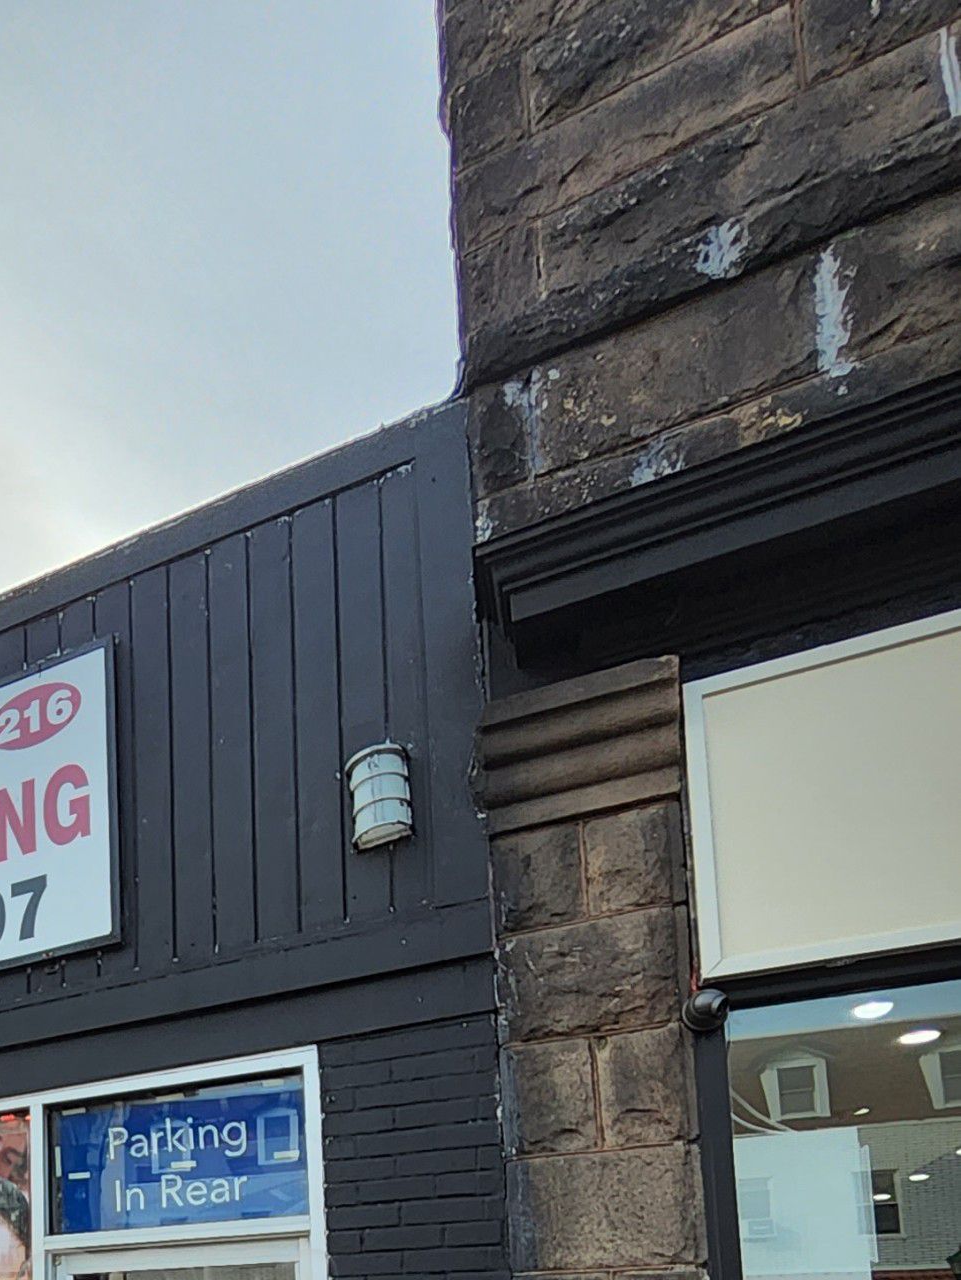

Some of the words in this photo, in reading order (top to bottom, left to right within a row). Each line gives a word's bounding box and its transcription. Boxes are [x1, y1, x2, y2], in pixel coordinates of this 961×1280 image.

[107, 1116, 247, 1160] Parking
[115, 1180, 145, 1212] In
[161, 1174, 248, 1208] Rear
